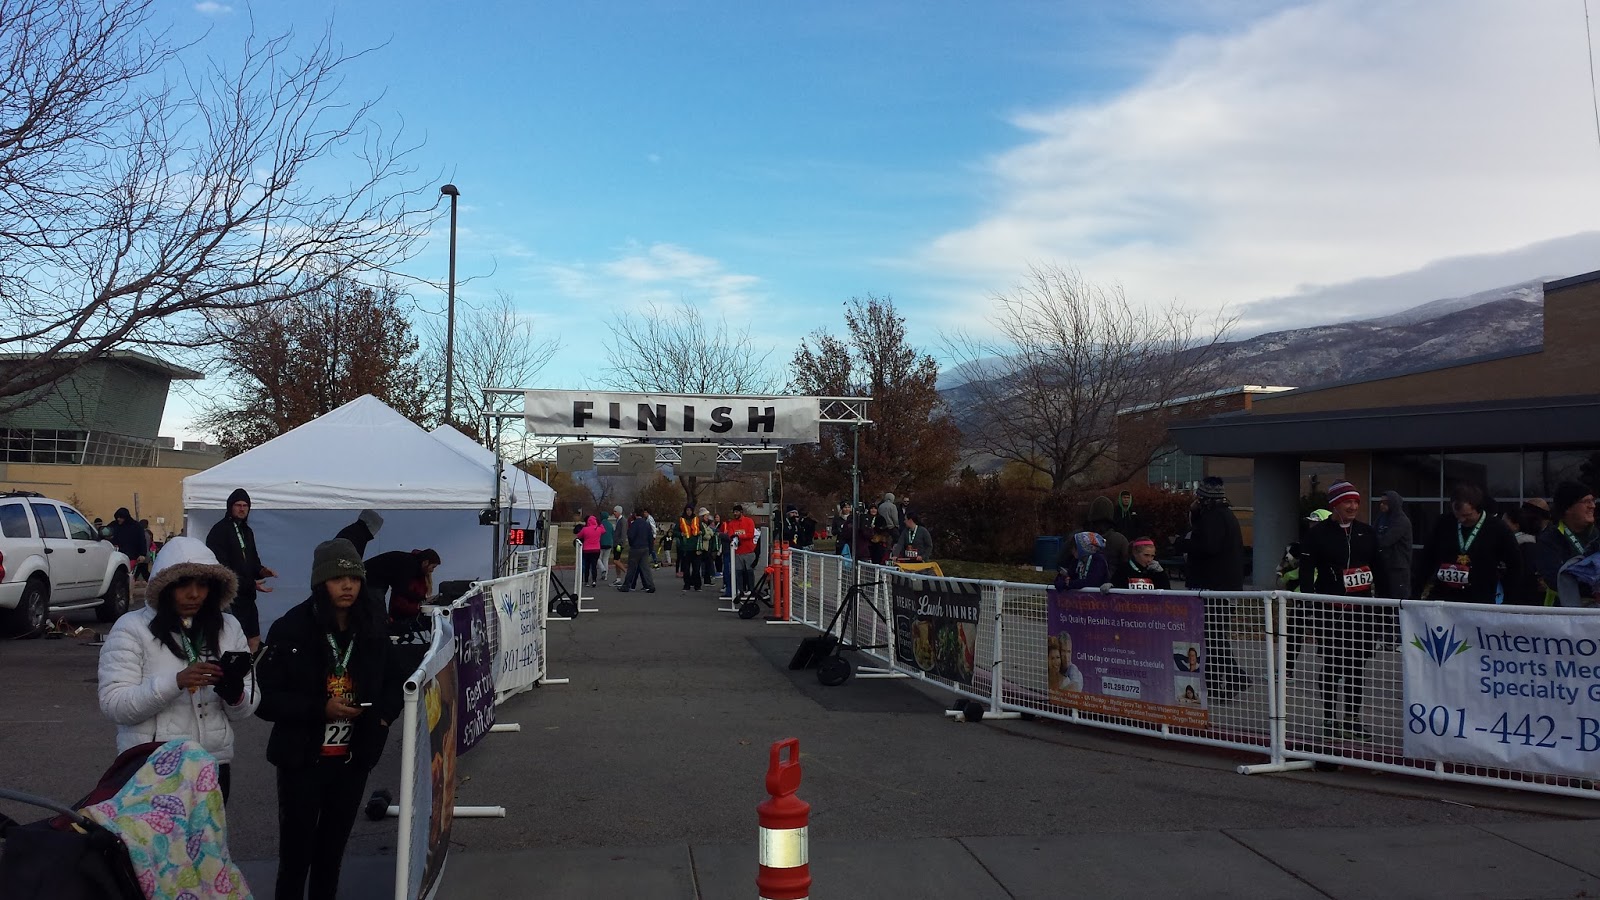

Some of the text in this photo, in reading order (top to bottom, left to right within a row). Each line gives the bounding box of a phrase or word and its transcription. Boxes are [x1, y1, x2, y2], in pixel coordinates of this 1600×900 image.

[573, 401, 776, 433] FINISH
[1346, 573, 1371, 587] 3162
[1440, 570, 1466, 582] 3337
[1087, 615, 1111, 626] Results
[1155, 620, 1166, 630] the
[1167, 621, 1186, 631] Cost!
[1477, 626, 1600, 656] Intermo
[1077, 652, 1087, 661] Call
[1087, 653, 1104, 664] today
[1139, 659, 1164, 669] schedule
[1480, 655, 1547, 677] Sports
[1480, 677, 1579, 705] Specialty
[326, 725, 352, 745] 22
[1408, 703, 1600, 752] 801-442-B
